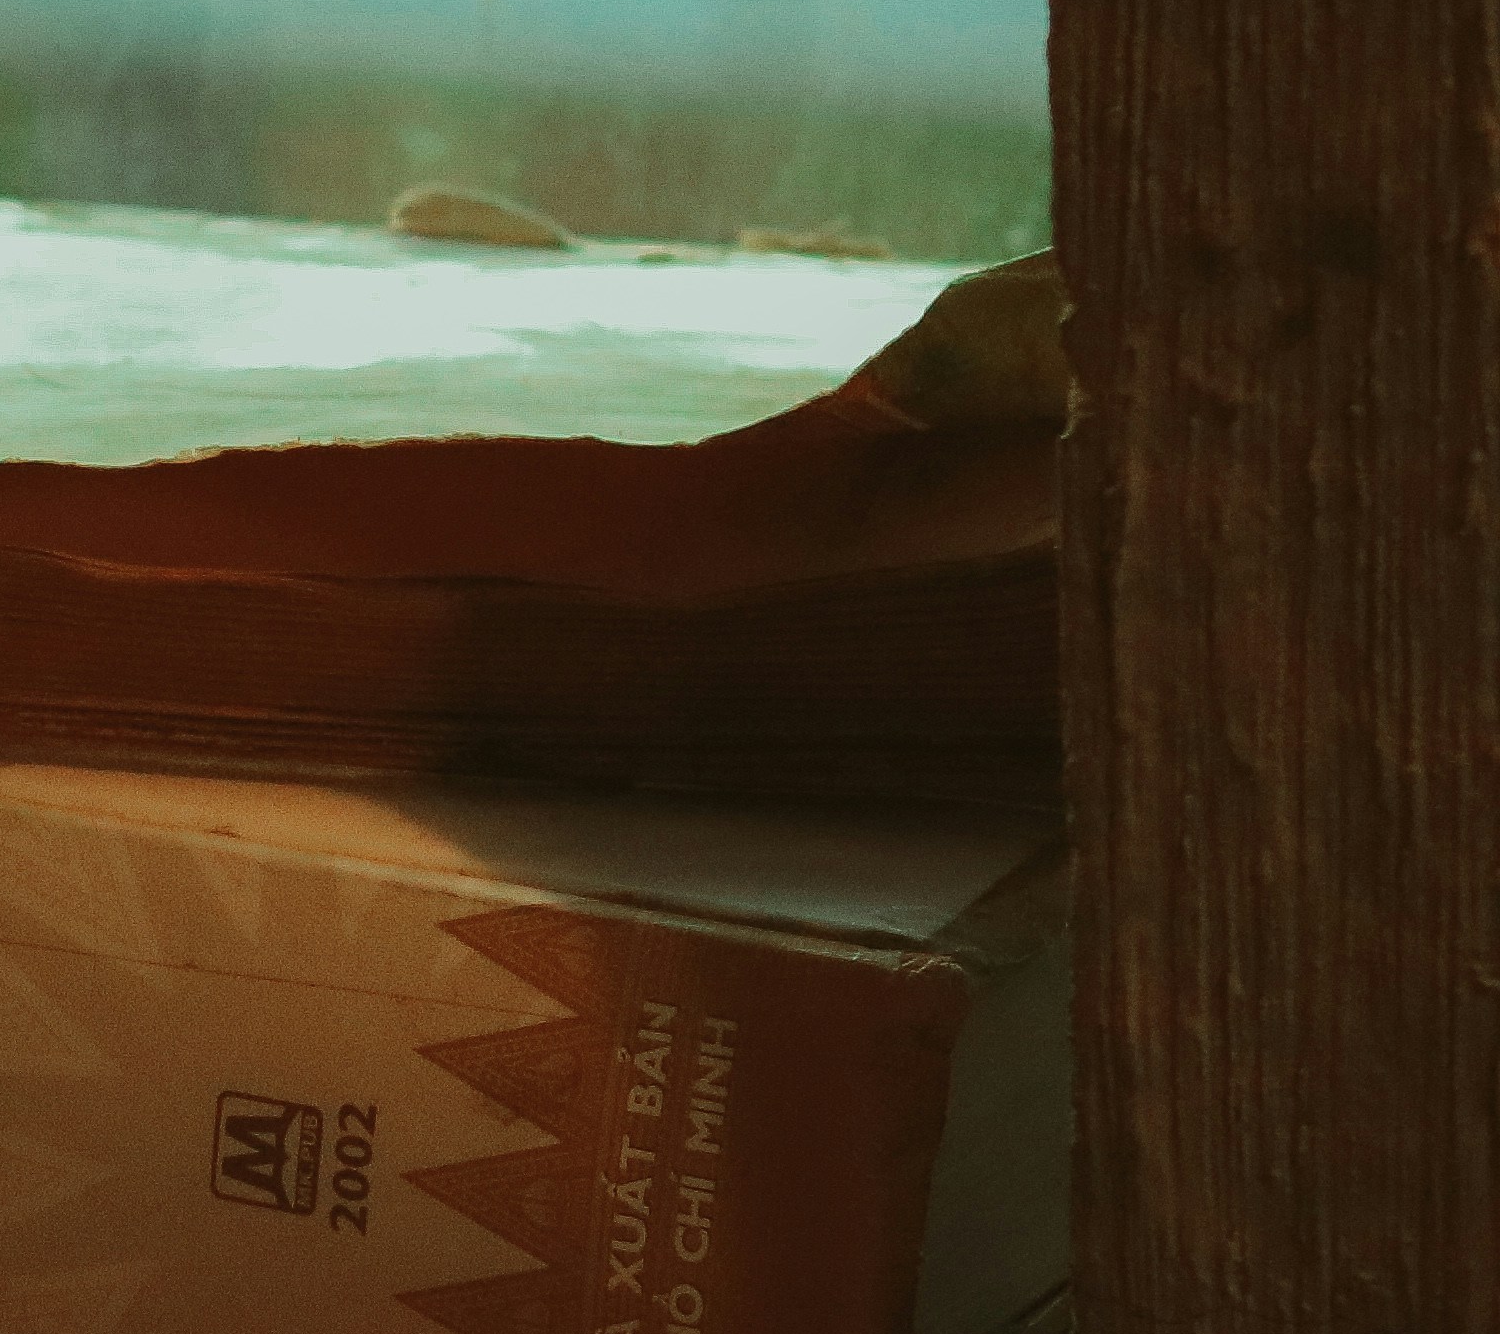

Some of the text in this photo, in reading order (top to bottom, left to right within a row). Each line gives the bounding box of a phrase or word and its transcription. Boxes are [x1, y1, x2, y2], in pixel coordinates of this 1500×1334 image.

[617, 1000, 678, 1118] BẢN
[684, 1016, 739, 1155] MINH
[329, 1102, 378, 1237] 2002
[601, 1134, 656, 1295] XUẤT
[669, 1170, 716, 1264] CHÍ
